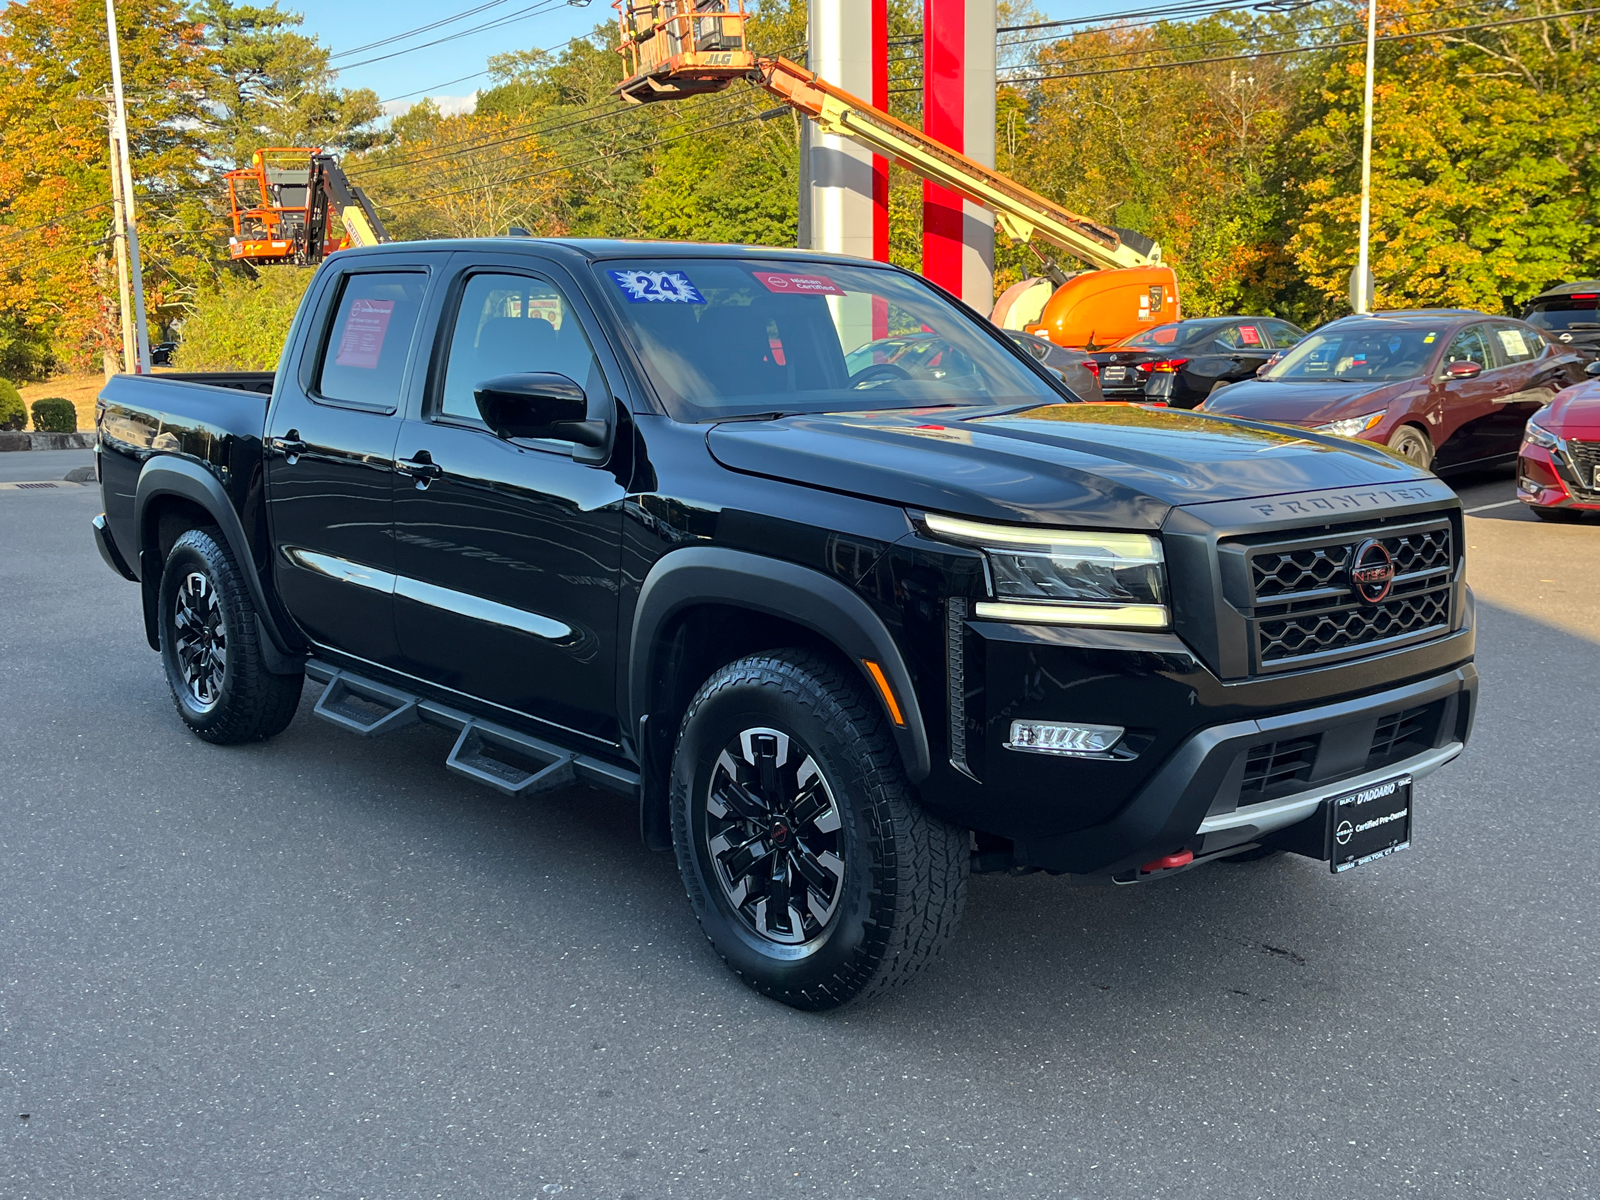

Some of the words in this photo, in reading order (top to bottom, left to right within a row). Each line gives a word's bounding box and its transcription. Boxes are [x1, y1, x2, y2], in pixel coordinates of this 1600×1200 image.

[706, 53, 732, 65] JLG
[636, 275, 679, 295] 24
[789, 277, 822, 285] Nissan
[796, 283, 836, 291] Certified
[1251, 487, 1433, 517] FRONTIER
[1357, 783, 1395, 805] D'ADDARIO
[1355, 818, 1379, 833] Certified
[1379, 808, 1408, 825] Pre-Owned
